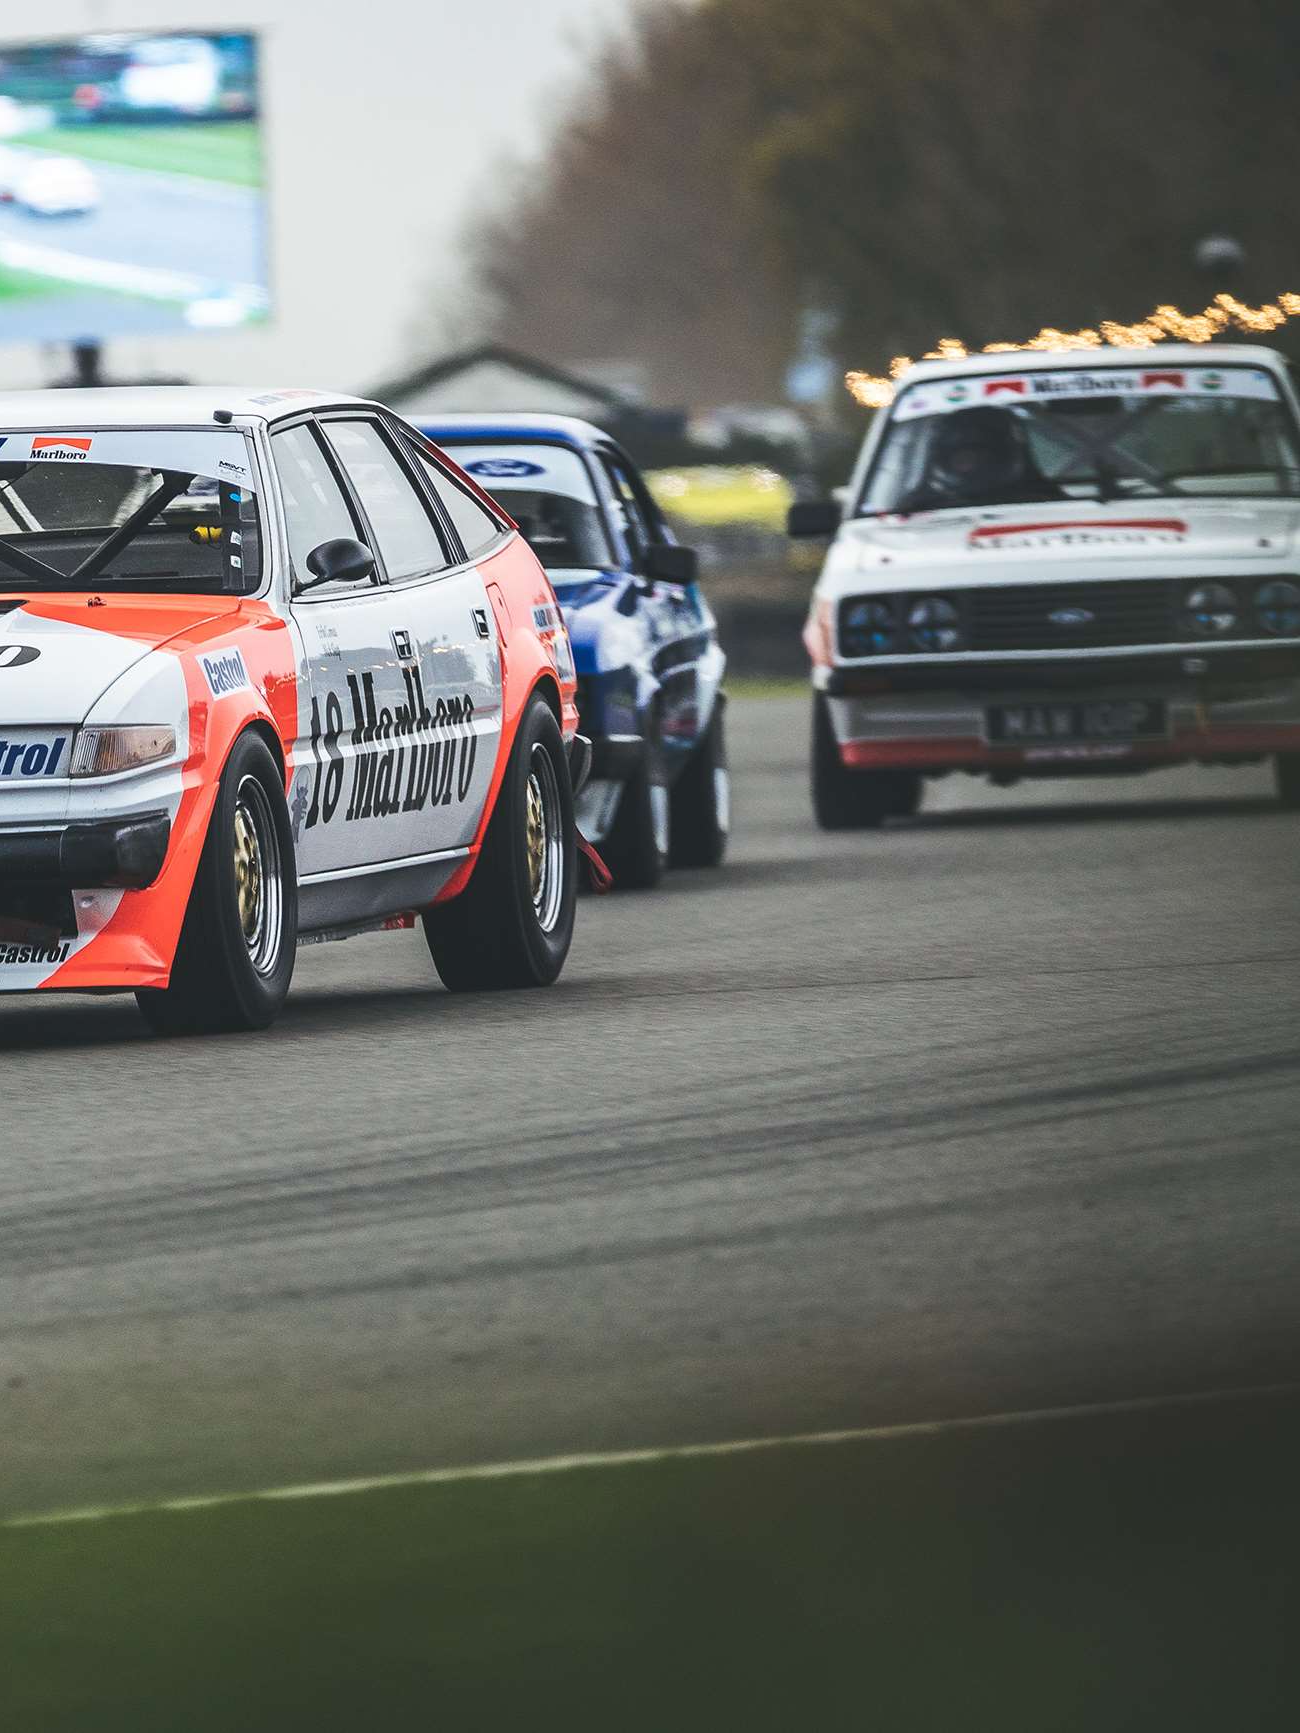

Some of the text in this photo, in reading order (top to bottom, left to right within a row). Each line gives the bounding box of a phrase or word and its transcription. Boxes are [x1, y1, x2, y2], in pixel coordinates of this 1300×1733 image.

[29, 449, 87, 461] Marlboro
[203, 650, 246, 694] Castrol
[304, 665, 478, 829] 18 Marlboro
